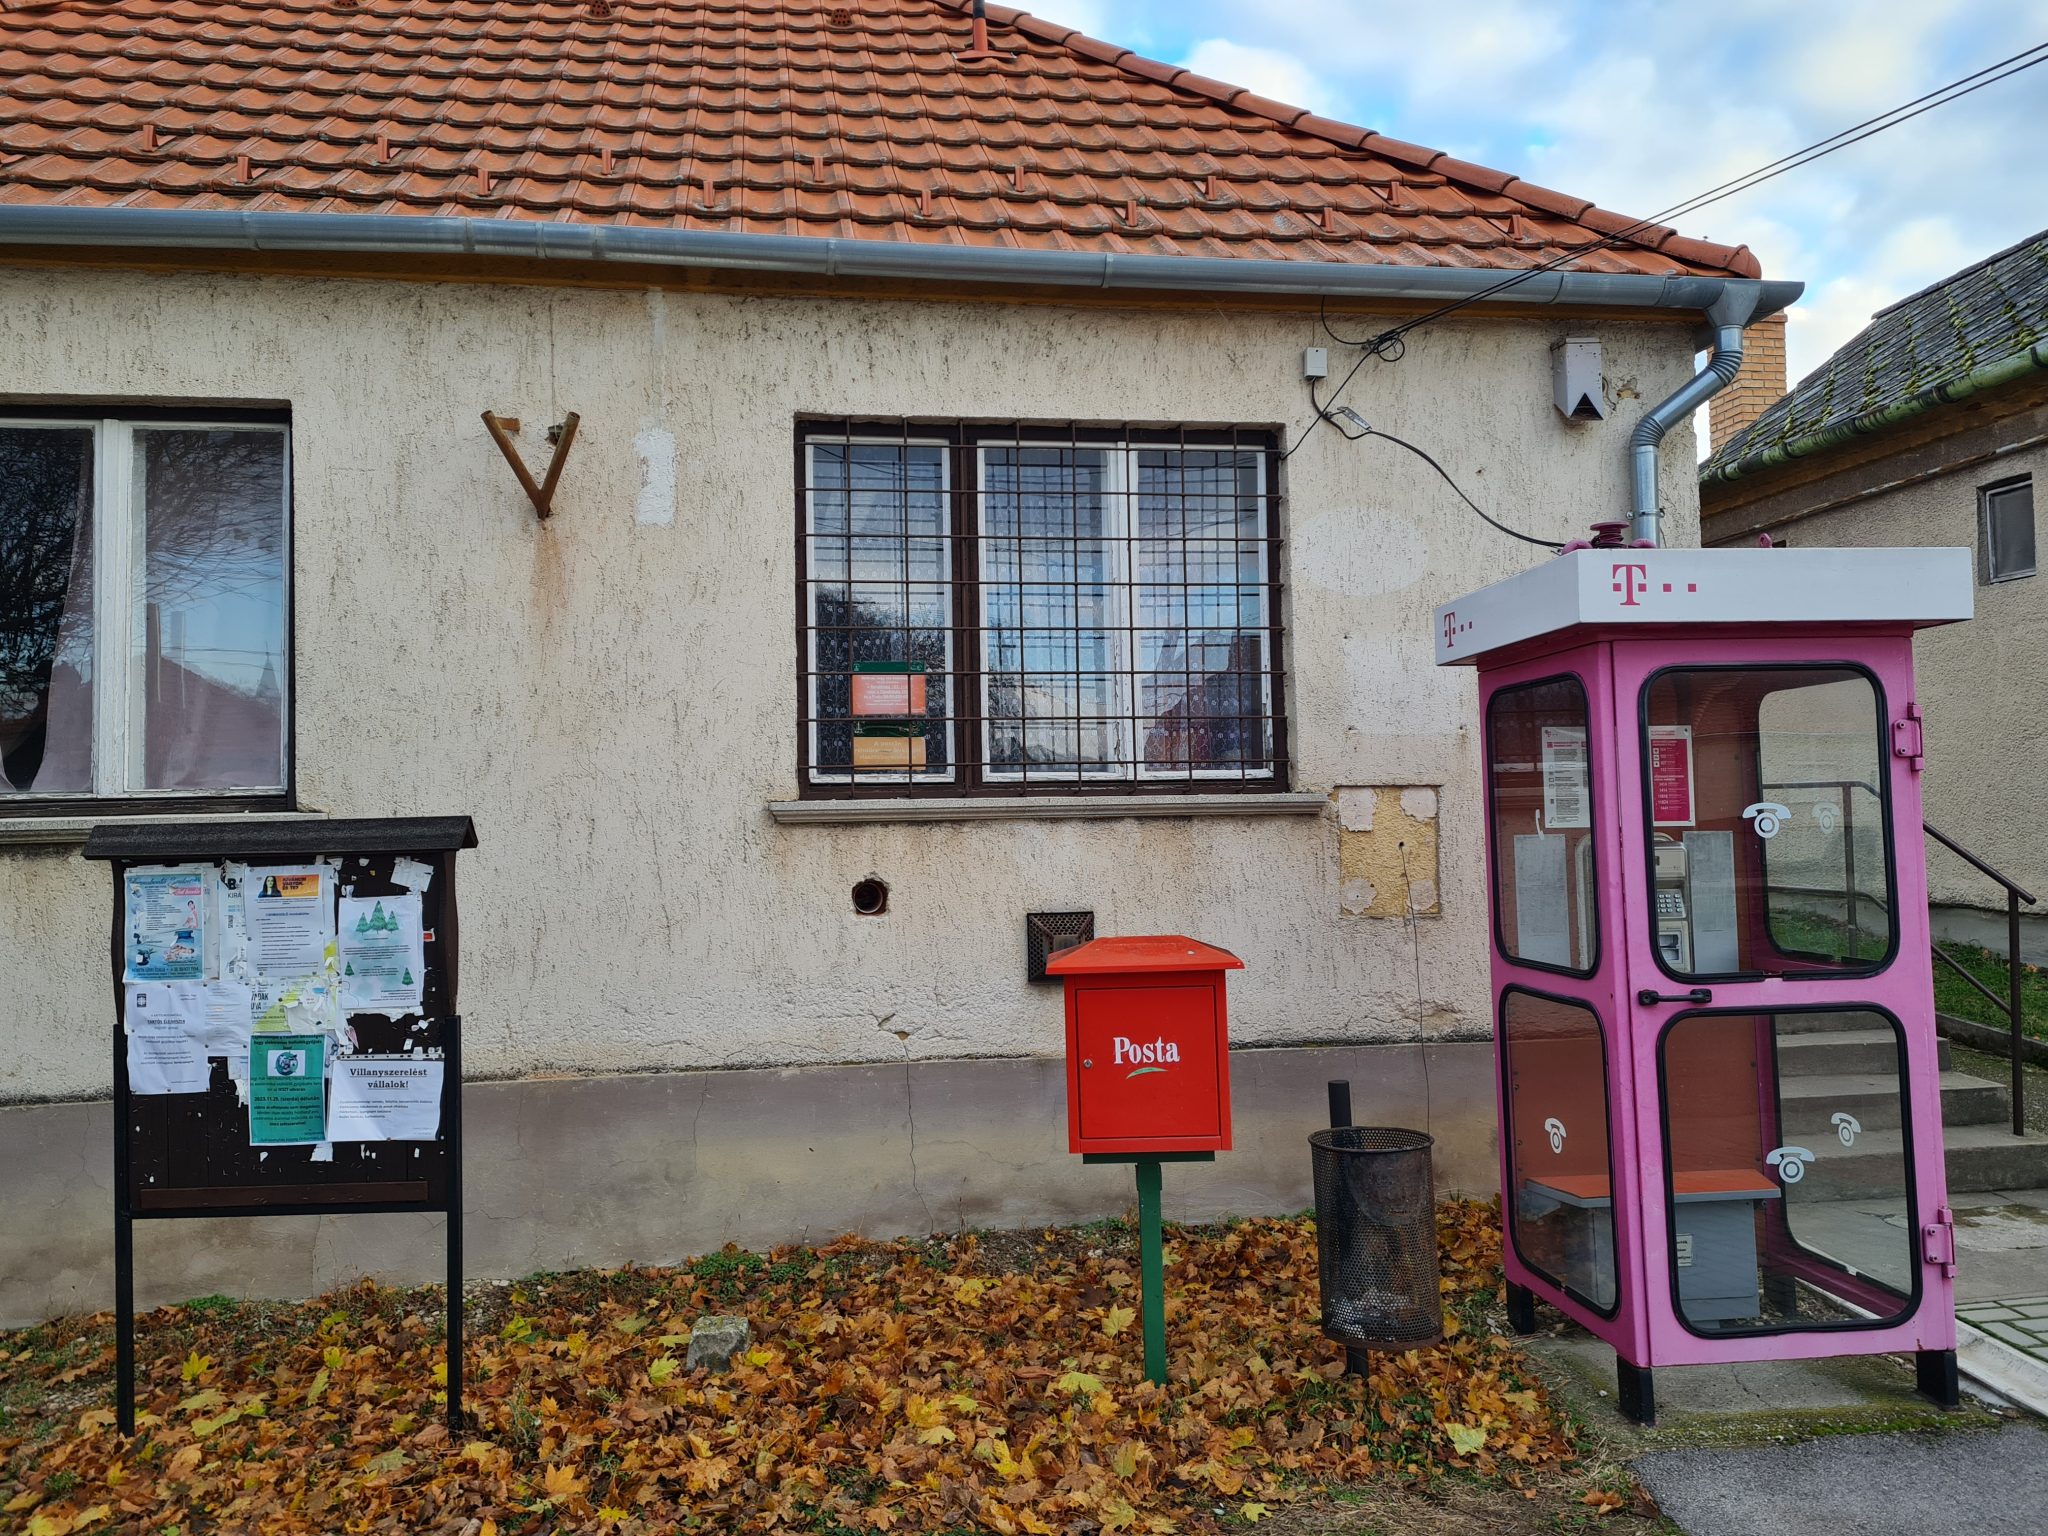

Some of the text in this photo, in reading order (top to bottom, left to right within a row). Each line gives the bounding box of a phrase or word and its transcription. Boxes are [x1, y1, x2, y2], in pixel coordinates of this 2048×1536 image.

[1113, 1036, 1180, 1064] Posta
[349, 1068, 428, 1077] Villanyszerelést
[367, 1080, 409, 1089] vállalok!
